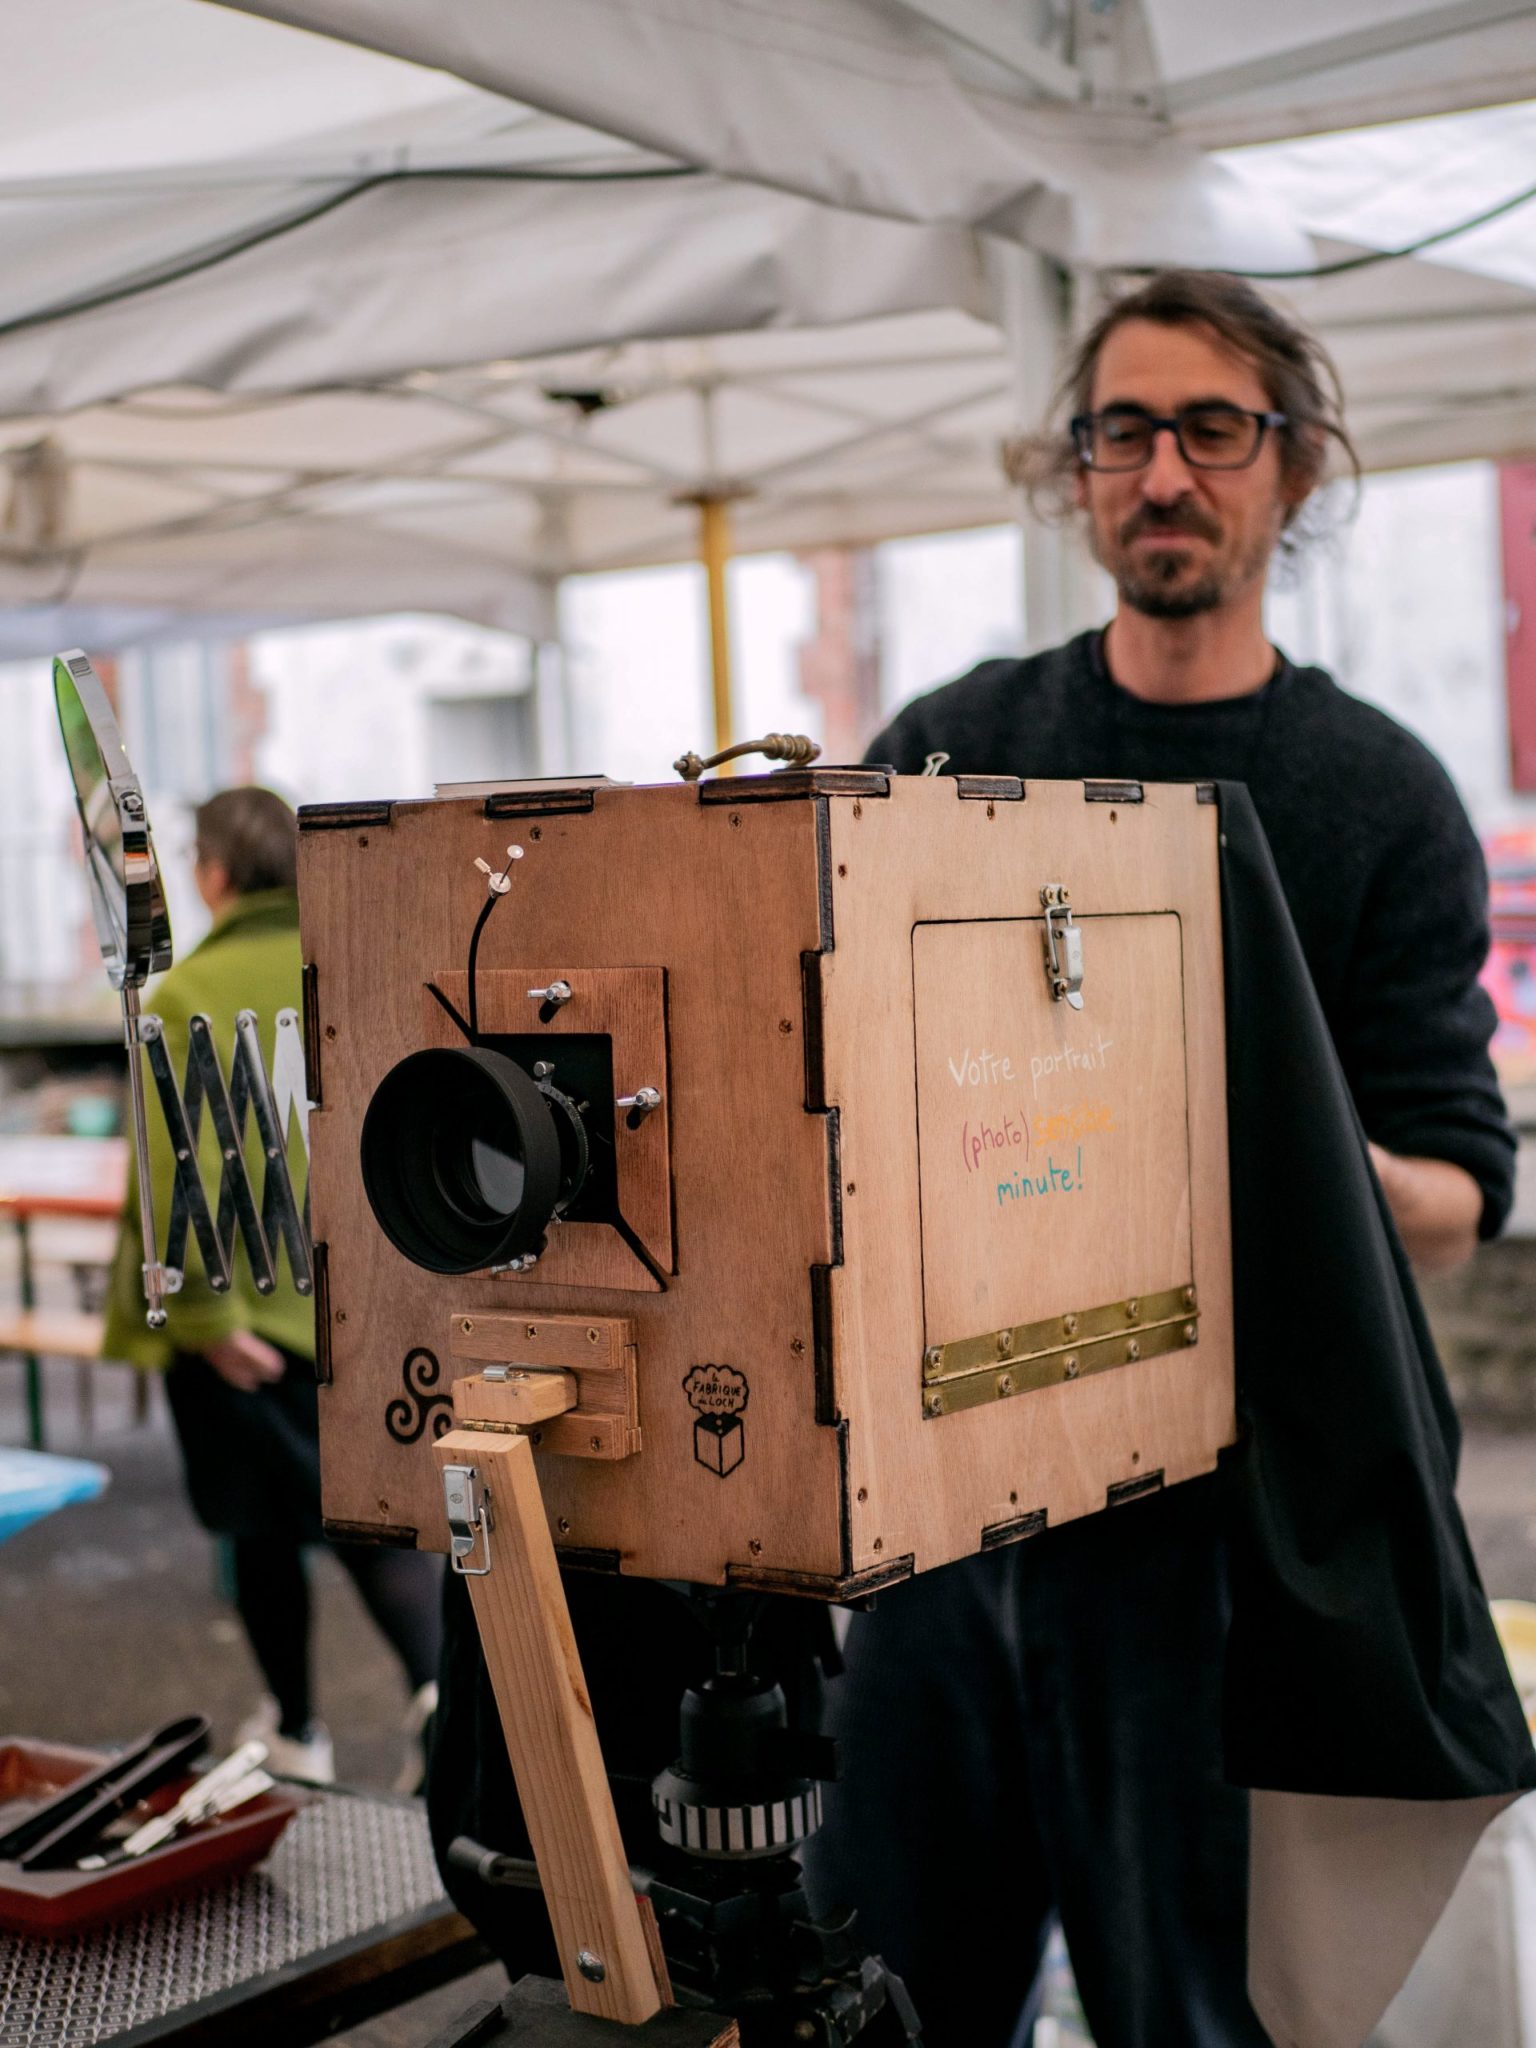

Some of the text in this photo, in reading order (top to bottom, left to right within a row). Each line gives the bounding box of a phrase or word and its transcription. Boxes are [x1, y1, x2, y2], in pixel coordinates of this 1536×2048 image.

[949, 1033, 1113, 1101] Votre portrait
[962, 1109, 1029, 1173] (photo)
[996, 1146, 1083, 1206] minute!
[693, 1381, 742, 1397] FABRIQUE
[708, 1396, 735, 1409] LOCH
